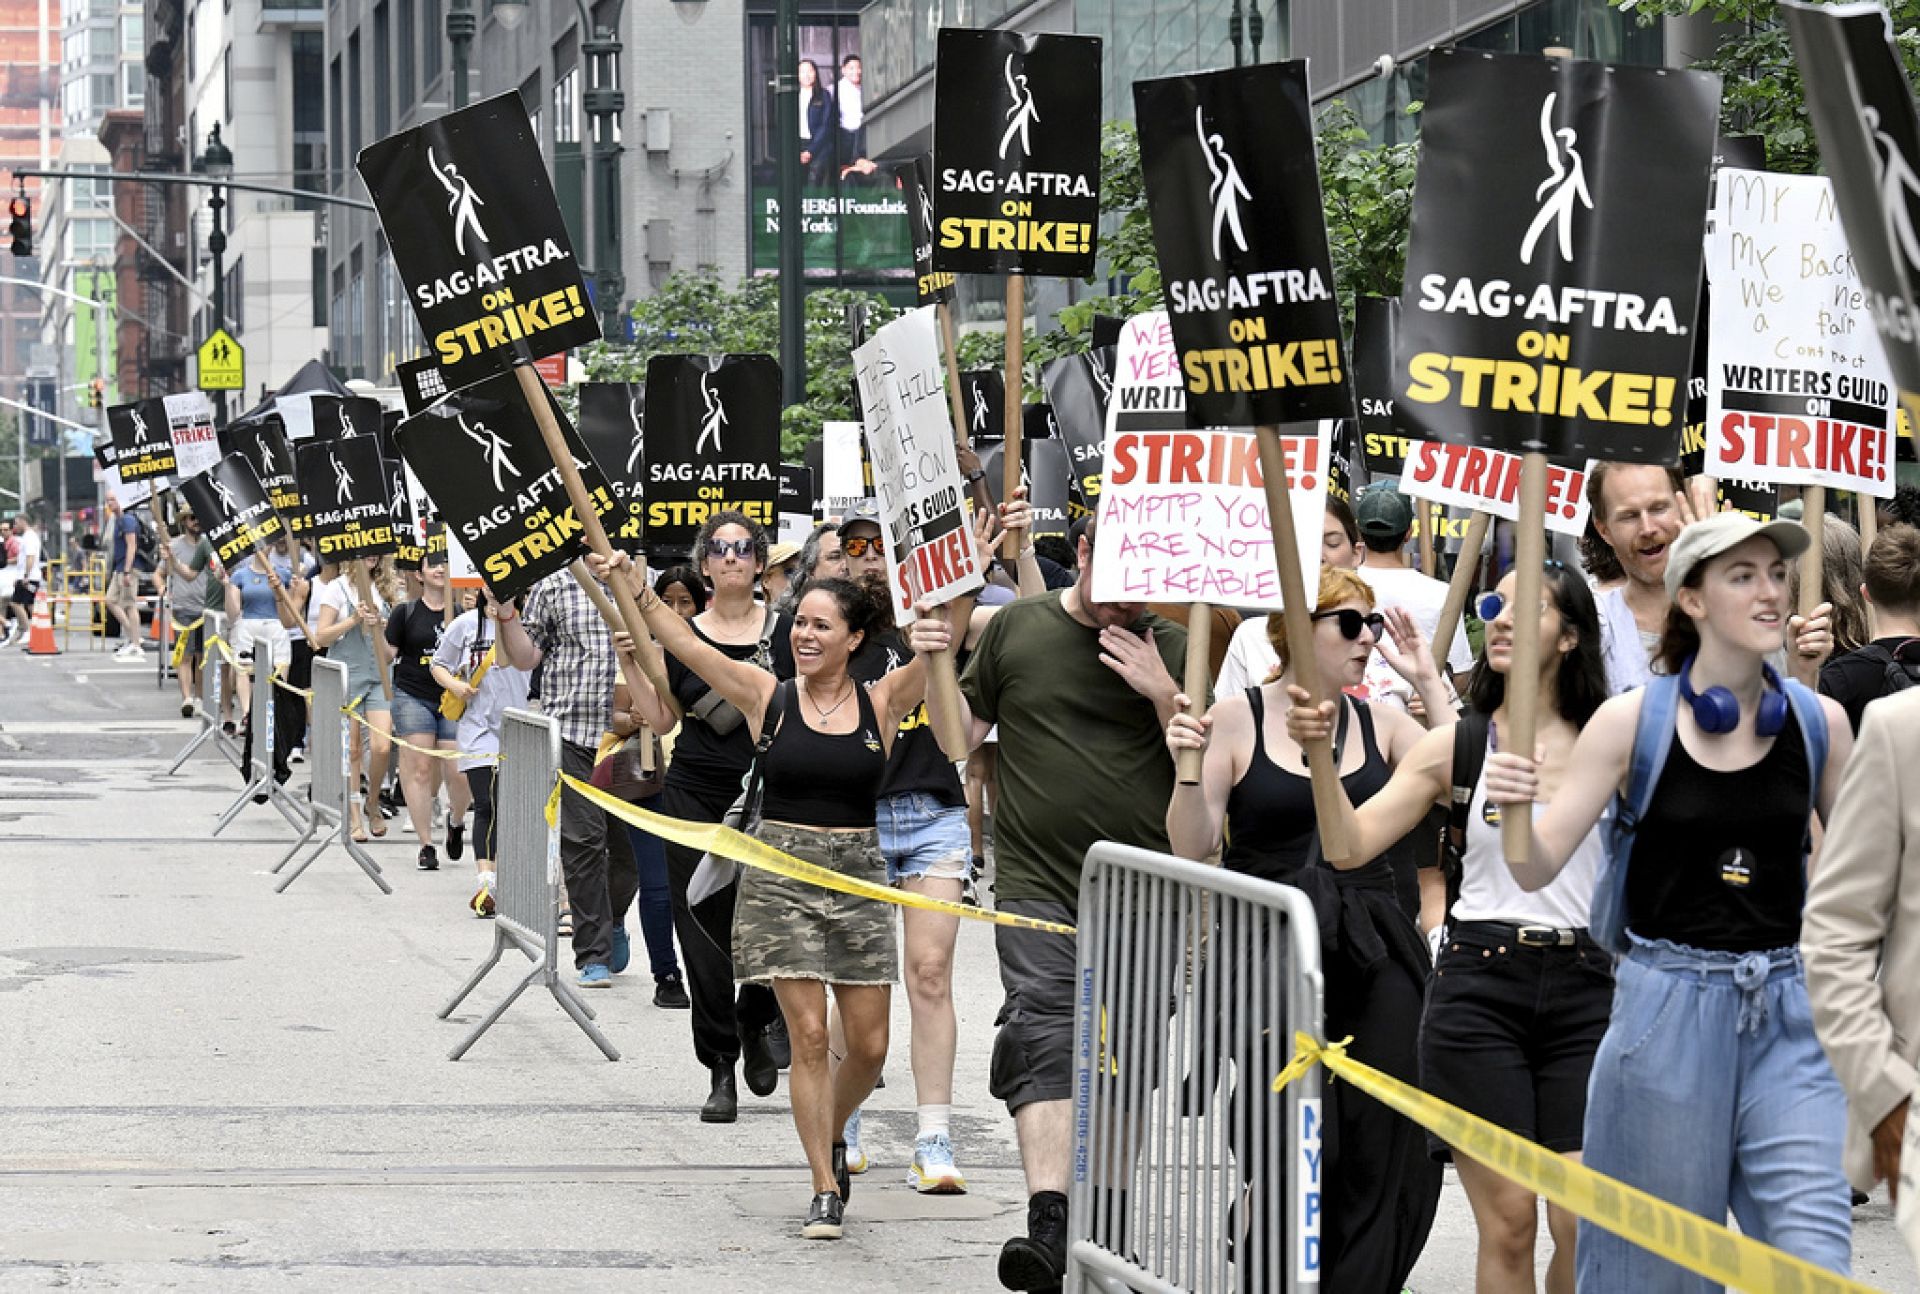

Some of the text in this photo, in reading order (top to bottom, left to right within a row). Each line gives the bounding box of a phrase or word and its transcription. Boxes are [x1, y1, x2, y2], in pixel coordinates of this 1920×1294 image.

[1001, 201, 1032, 217] ON
[939, 217, 1092, 254] STRIKE!
[481, 286, 515, 312] ON
[434, 284, 586, 365] STRIKE!
[1229, 316, 1267, 343] ON
[1516, 330, 1570, 362] ON
[203, 374, 241, 386] AHEAD
[1184, 339, 1344, 395] STRIKE!
[1405, 352, 1677, 428] STRIKE!
[1722, 364, 1832, 395] WRITERS
[1836, 374, 1888, 406] GUILD
[1806, 399, 1831, 418] ON
[1111, 433, 1320, 491] STRIKE!
[1719, 412, 1888, 483] STRIKE!
[697, 486, 724, 501] ON
[922, 485, 957, 520] GUILD
[345, 522, 361, 531] ON
[524, 507, 551, 531] ON
[218, 515, 282, 561] STRIKE!
[319, 526, 393, 553] STRIKE!
[1119, 532, 1274, 560] ARE NOT
[898, 526, 974, 610] SIKE!
